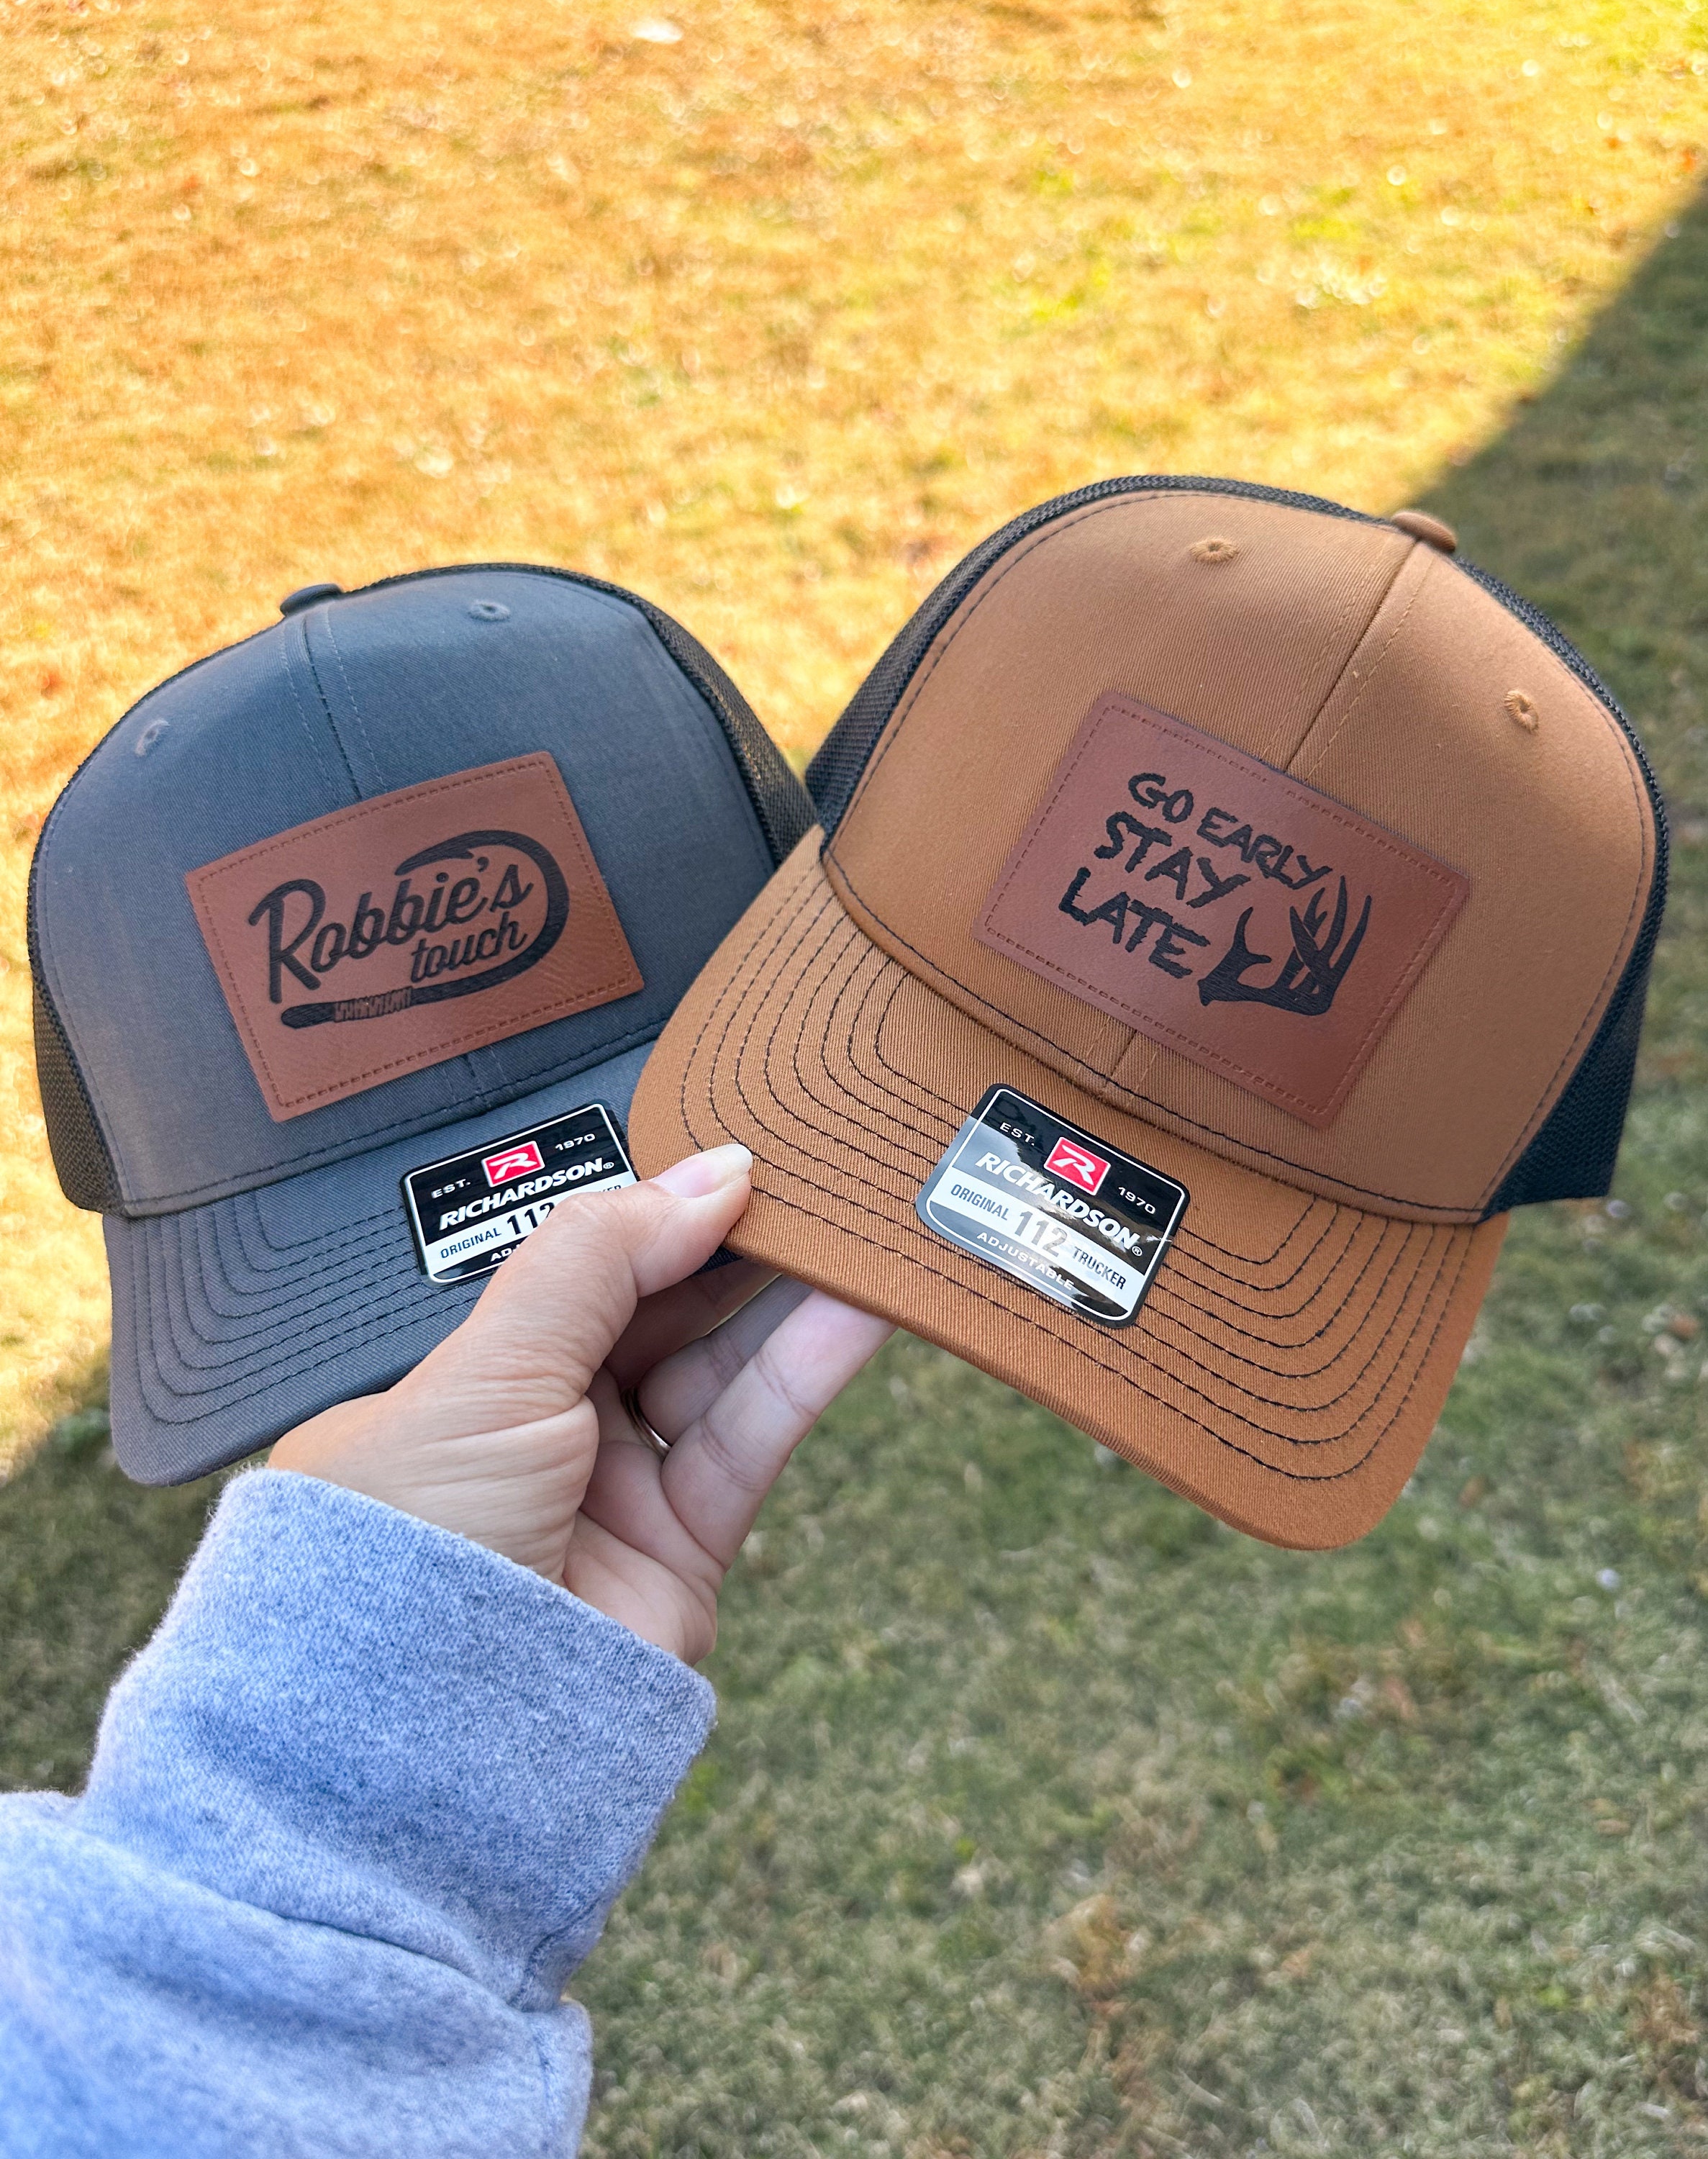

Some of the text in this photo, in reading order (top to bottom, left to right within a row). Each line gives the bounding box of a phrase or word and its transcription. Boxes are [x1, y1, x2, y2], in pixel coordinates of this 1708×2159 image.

[1094, 811, 1251, 908] STAY
[1128, 772, 1332, 890] GO EARLY
[248, 856, 534, 1005] Robbie's
[409, 911, 528, 983] touch
[1058, 866, 1211, 979] LATE
[432, 1133, 596, 1199] EST. 1970
[999, 1122, 1157, 1215] EST. 1970
[440, 1227, 502, 1259] ORIGINAL
[950, 1183, 1127, 1290] ORIGINAL 112 TRUCKER
[976, 1231, 1076, 1291] ADJUSTABLE
